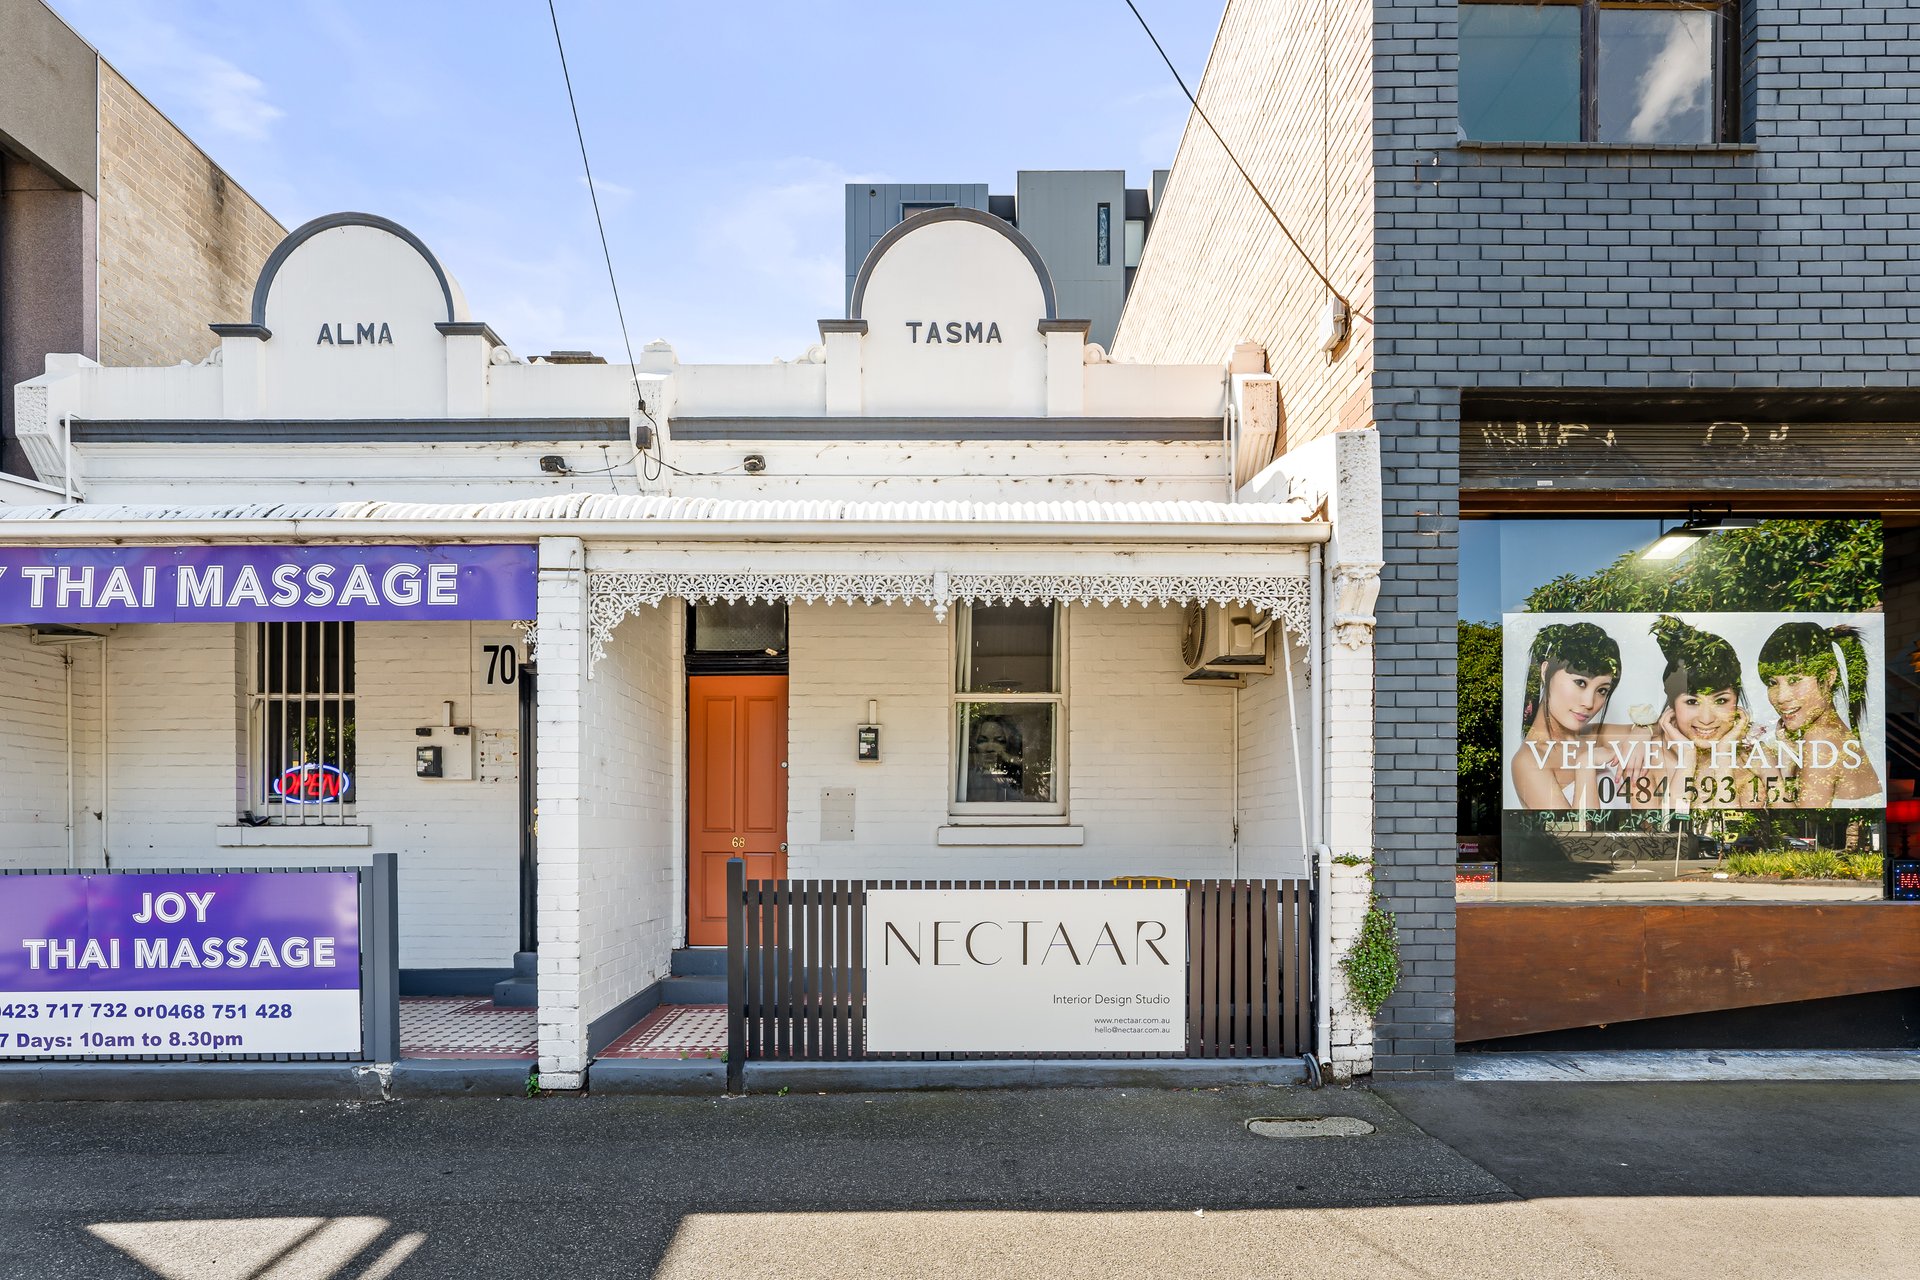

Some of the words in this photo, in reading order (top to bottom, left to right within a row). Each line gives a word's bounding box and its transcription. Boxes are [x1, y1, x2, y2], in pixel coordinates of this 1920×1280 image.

[317, 323, 392, 344] ALMA
[906, 322, 1001, 344] TASMA
[21, 566, 156, 608] THAI
[175, 563, 459, 608] MASSAGE
[483, 644, 515, 685] 70
[1526, 740, 1694, 770] VELVET
[1708, 739, 1861, 769] HANDS
[279, 773, 341, 796] OPEN
[1598, 776, 1670, 804] 0484
[1683, 776, 1736, 804] 593
[732, 837, 746, 848] 68
[132, 892, 216, 924] JOY
[22, 938, 120, 969] THAI
[134, 937, 336, 969] MASSAGE
[885, 921, 1170, 966] NECTAAR
[0, 1003, 39, 1019] 423
[46, 1003, 83, 1018] 717
[91, 1003, 127, 1018] 732
[212, 1004, 247, 1019] 751
[255, 1004, 292, 1019] 428
[1053, 994, 1092, 1005] Interior
[1095, 993, 1132, 1007] Design
[1136, 993, 1171, 1005] Studio
[1093, 1017, 1171, 1025] www.nectaar.com.au
[1094, 1026, 1170, 1034] hello@nectaar.com.au
[0, 1033, 9, 1048] 7
[17, 1033, 72, 1051] Days:
[80, 1032, 135, 1048] 10am
[142, 1032, 162, 1047] to
[169, 1032, 243, 1050] 8.30pm
